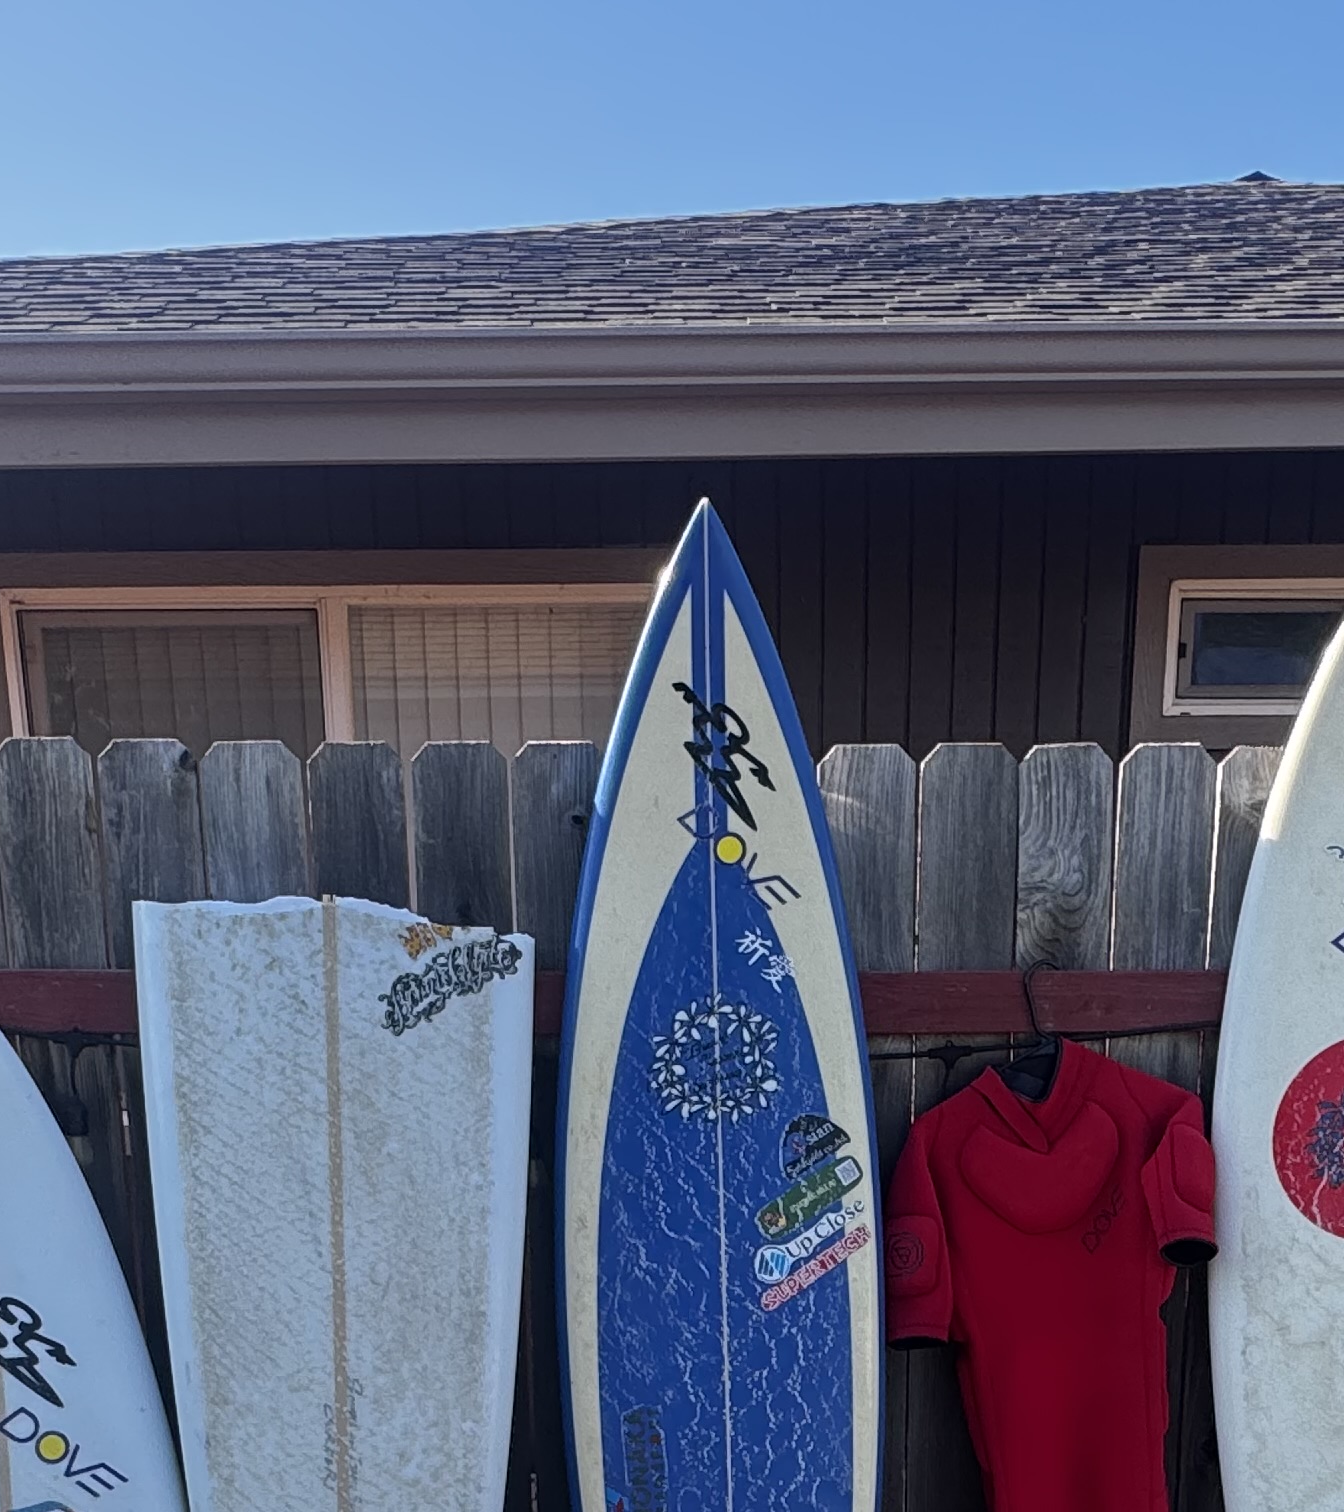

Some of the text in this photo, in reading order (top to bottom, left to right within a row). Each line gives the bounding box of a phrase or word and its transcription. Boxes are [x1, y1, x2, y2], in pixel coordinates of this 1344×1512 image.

[676, 804, 802, 911] DOVE
[761, 1225, 871, 1311] SUPERTECH
[786, 1200, 865, 1258] Up Close
